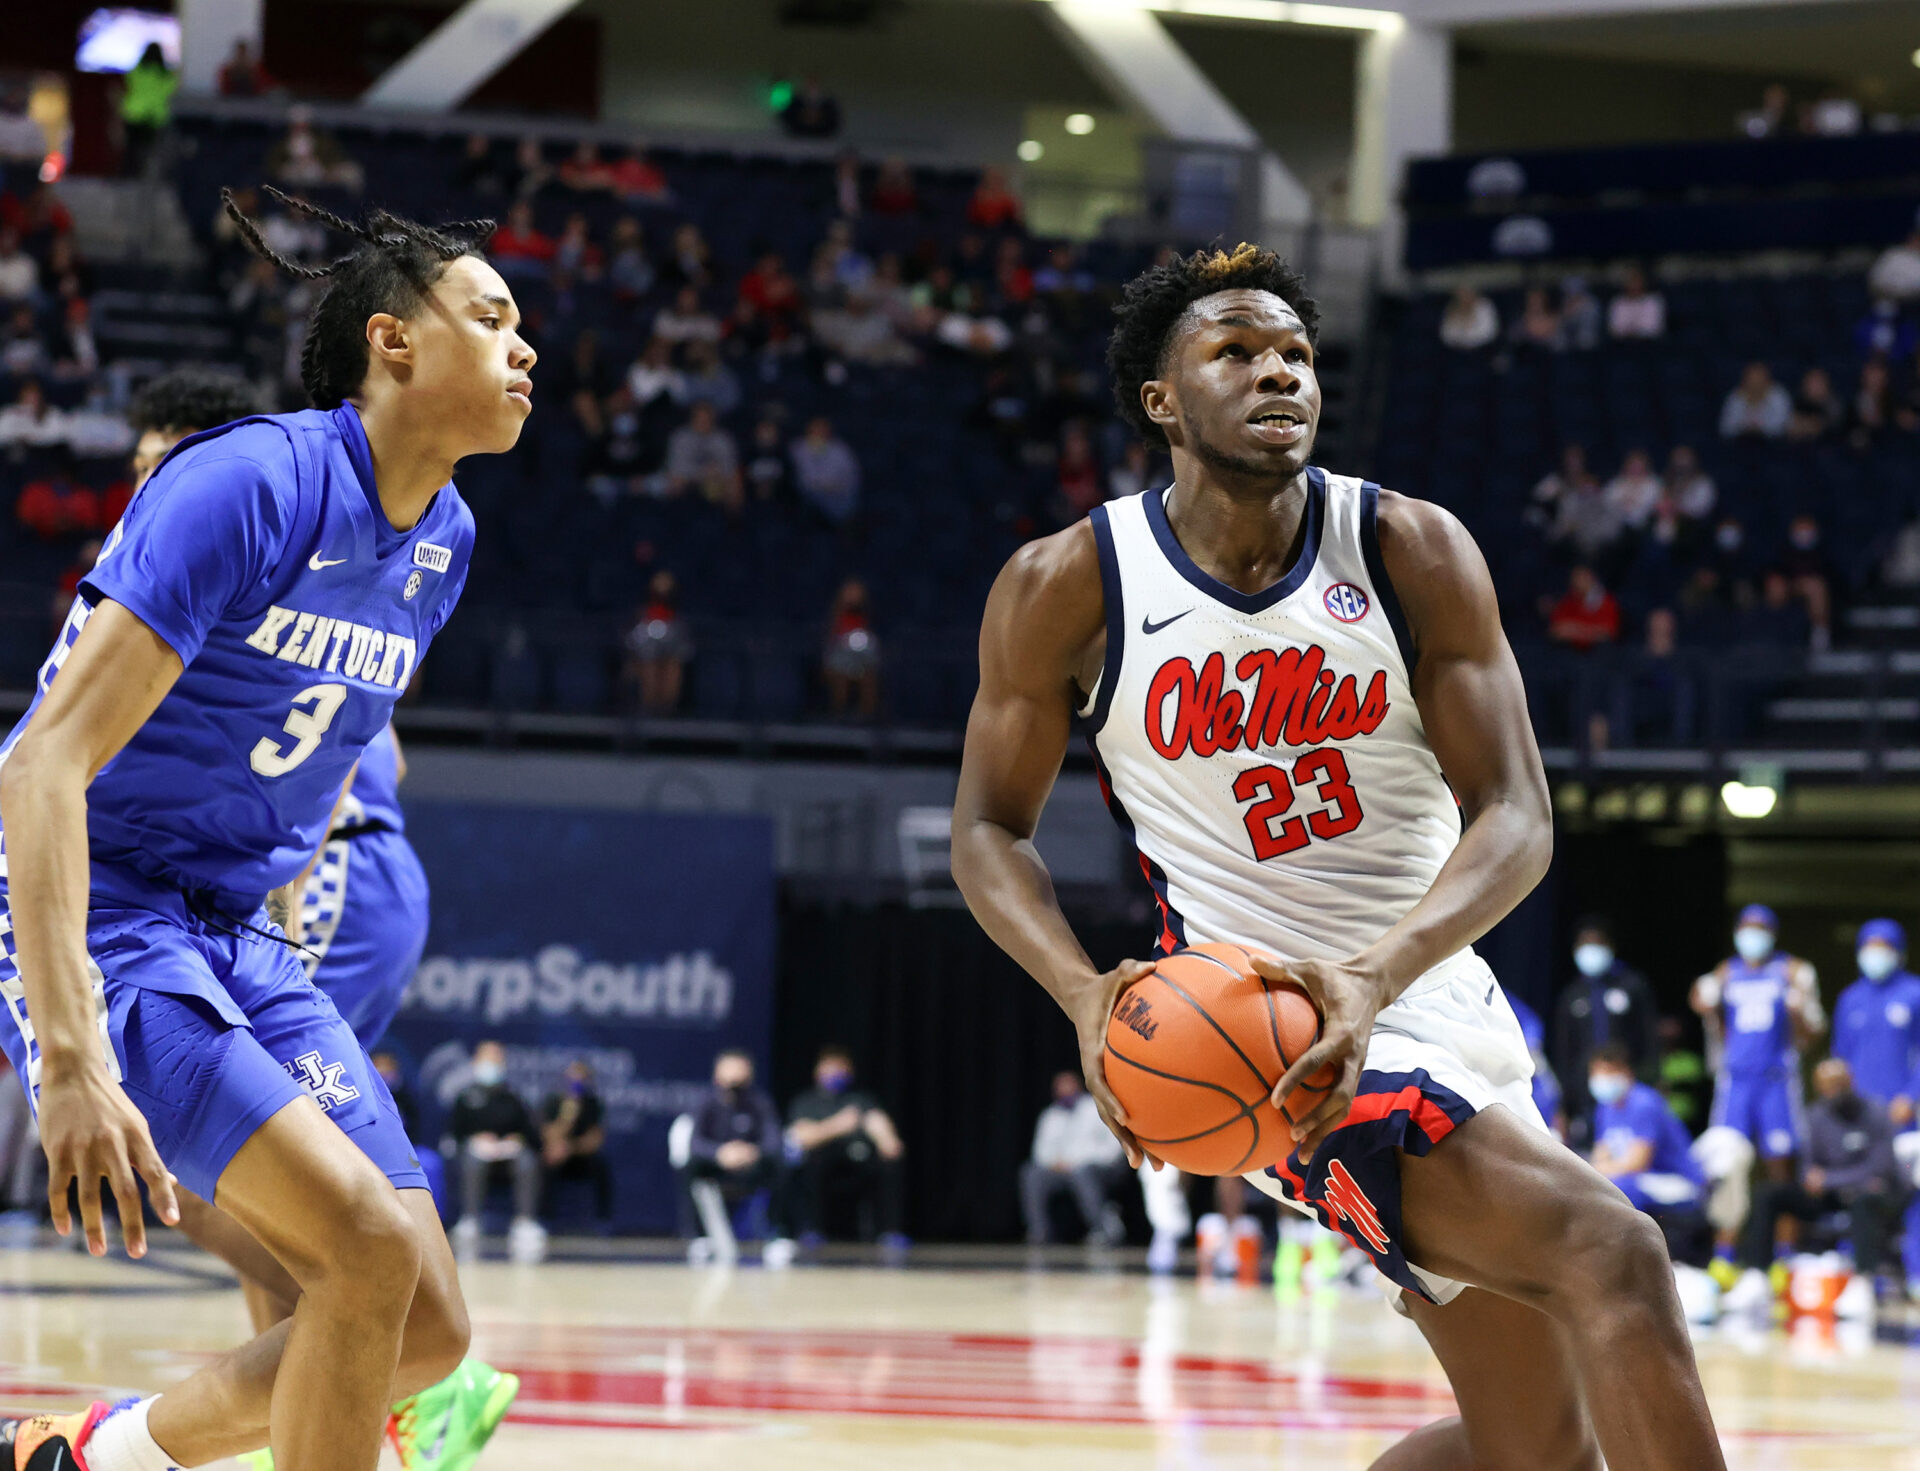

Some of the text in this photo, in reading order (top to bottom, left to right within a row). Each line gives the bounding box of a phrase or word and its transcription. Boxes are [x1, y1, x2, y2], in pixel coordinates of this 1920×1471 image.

[1325, 584, 1367, 620] SEC
[245, 605, 416, 690] KENTUCKY
[250, 683, 347, 777] 3
[1145, 645, 1391, 760] Ole Miss
[1232, 747, 1364, 862] 23
[397, 947, 733, 1022] orpSouth
